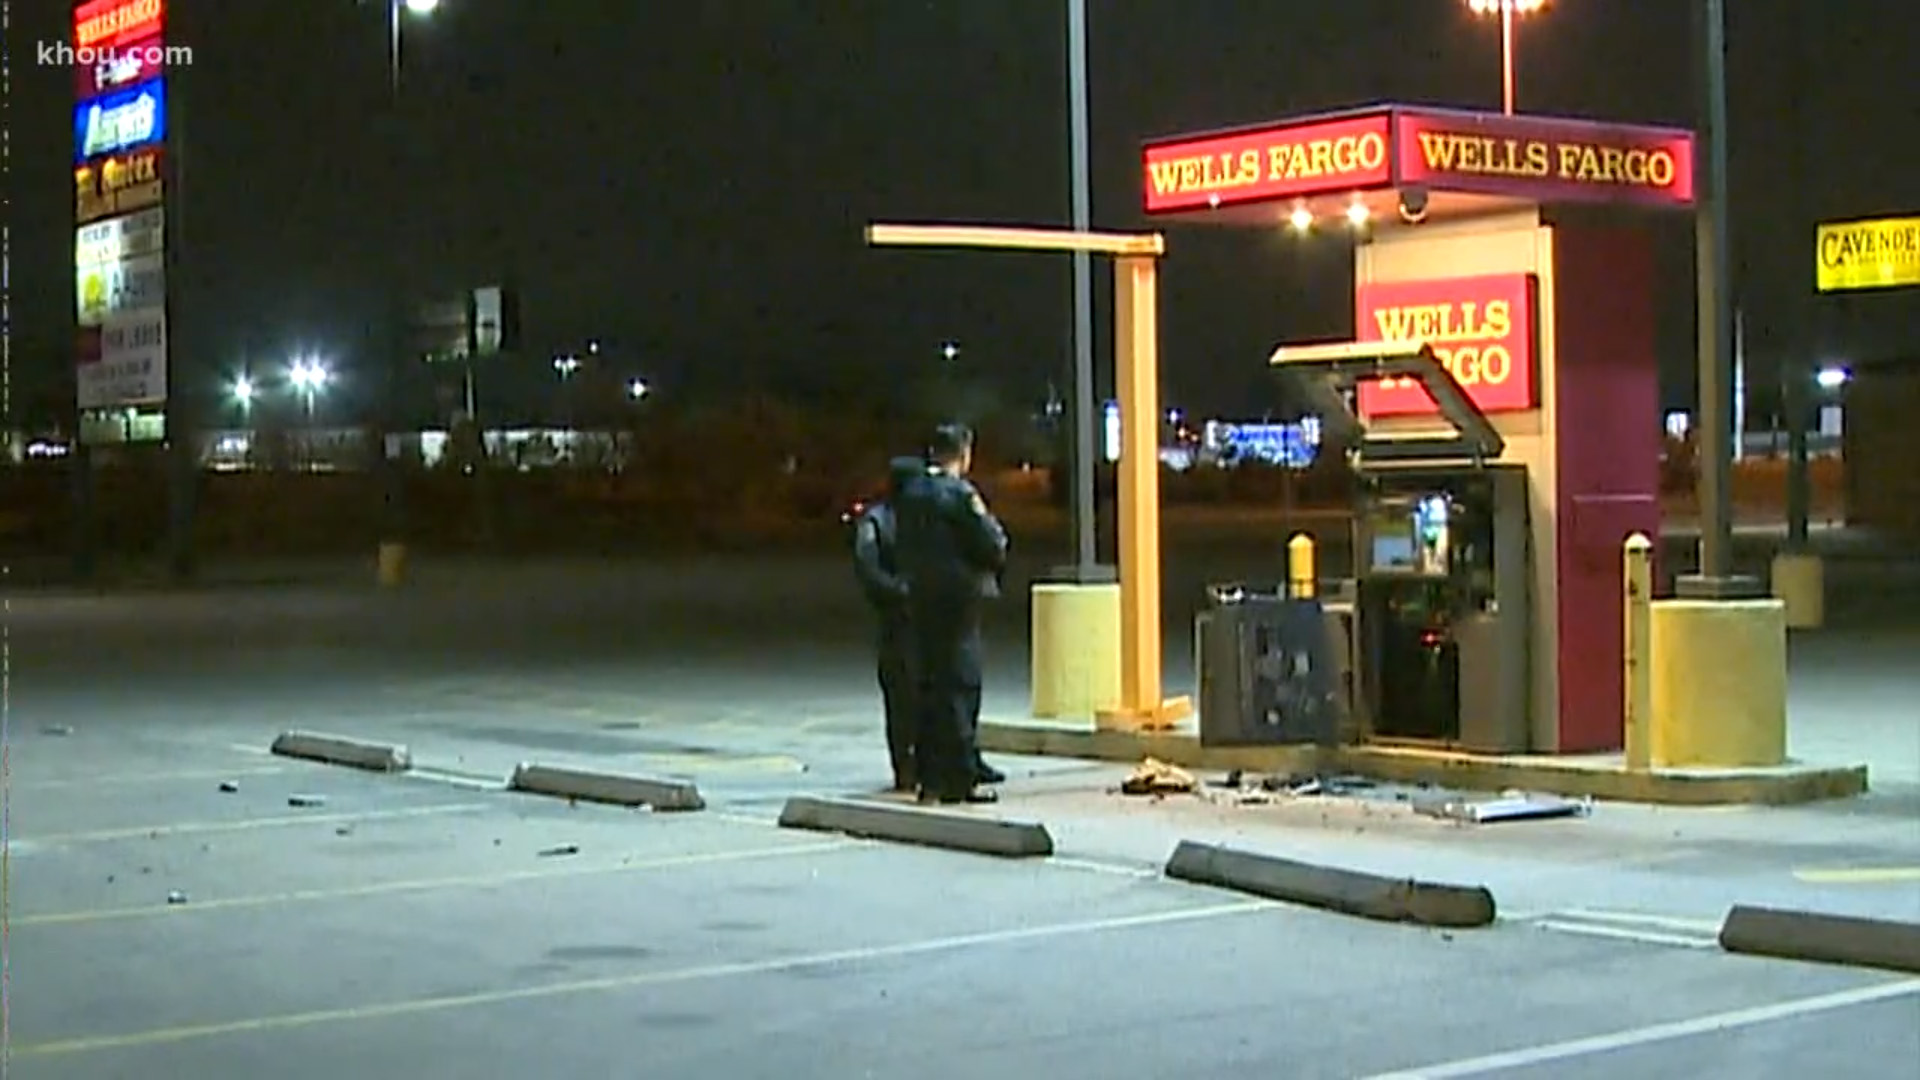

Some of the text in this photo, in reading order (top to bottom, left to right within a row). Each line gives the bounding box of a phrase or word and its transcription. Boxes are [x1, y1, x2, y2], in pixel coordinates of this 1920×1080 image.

[1150, 131, 1385, 196] WELLS FARGO
[1418, 131, 1674, 186] WELLS FARGO
[1374, 300, 1511, 343] WELLS
